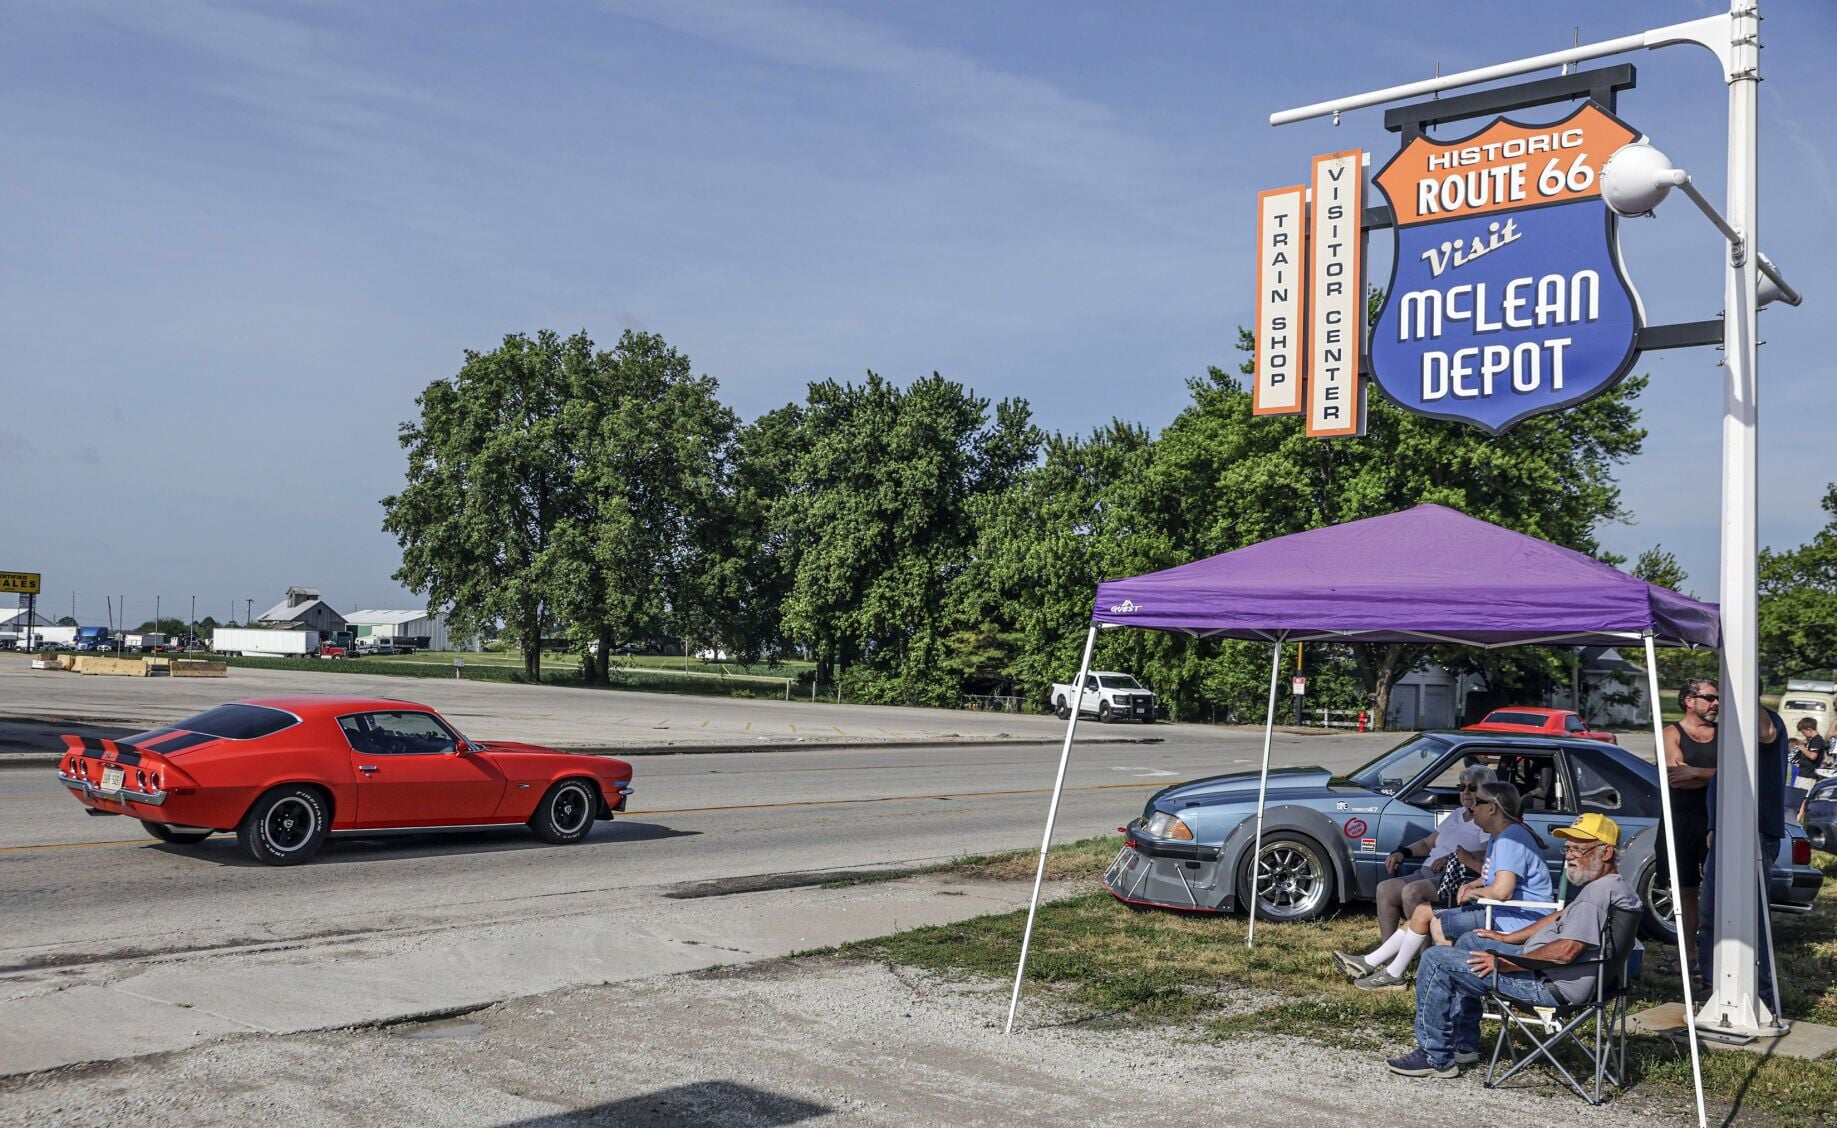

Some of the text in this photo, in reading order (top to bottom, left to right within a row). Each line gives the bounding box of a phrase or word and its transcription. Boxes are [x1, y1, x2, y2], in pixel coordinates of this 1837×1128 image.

[1428, 128, 1584, 171] HISTORIC
[1418, 153, 1595, 216] ROUTE 66
[1421, 218, 1523, 278] Visit
[1269, 213, 1289, 388] TRAIN SHOP
[1322, 166, 1345, 421] VISITOR CENTER
[1422, 338, 1572, 401] DEPOT
[0, 580, 36, 588] ALES
